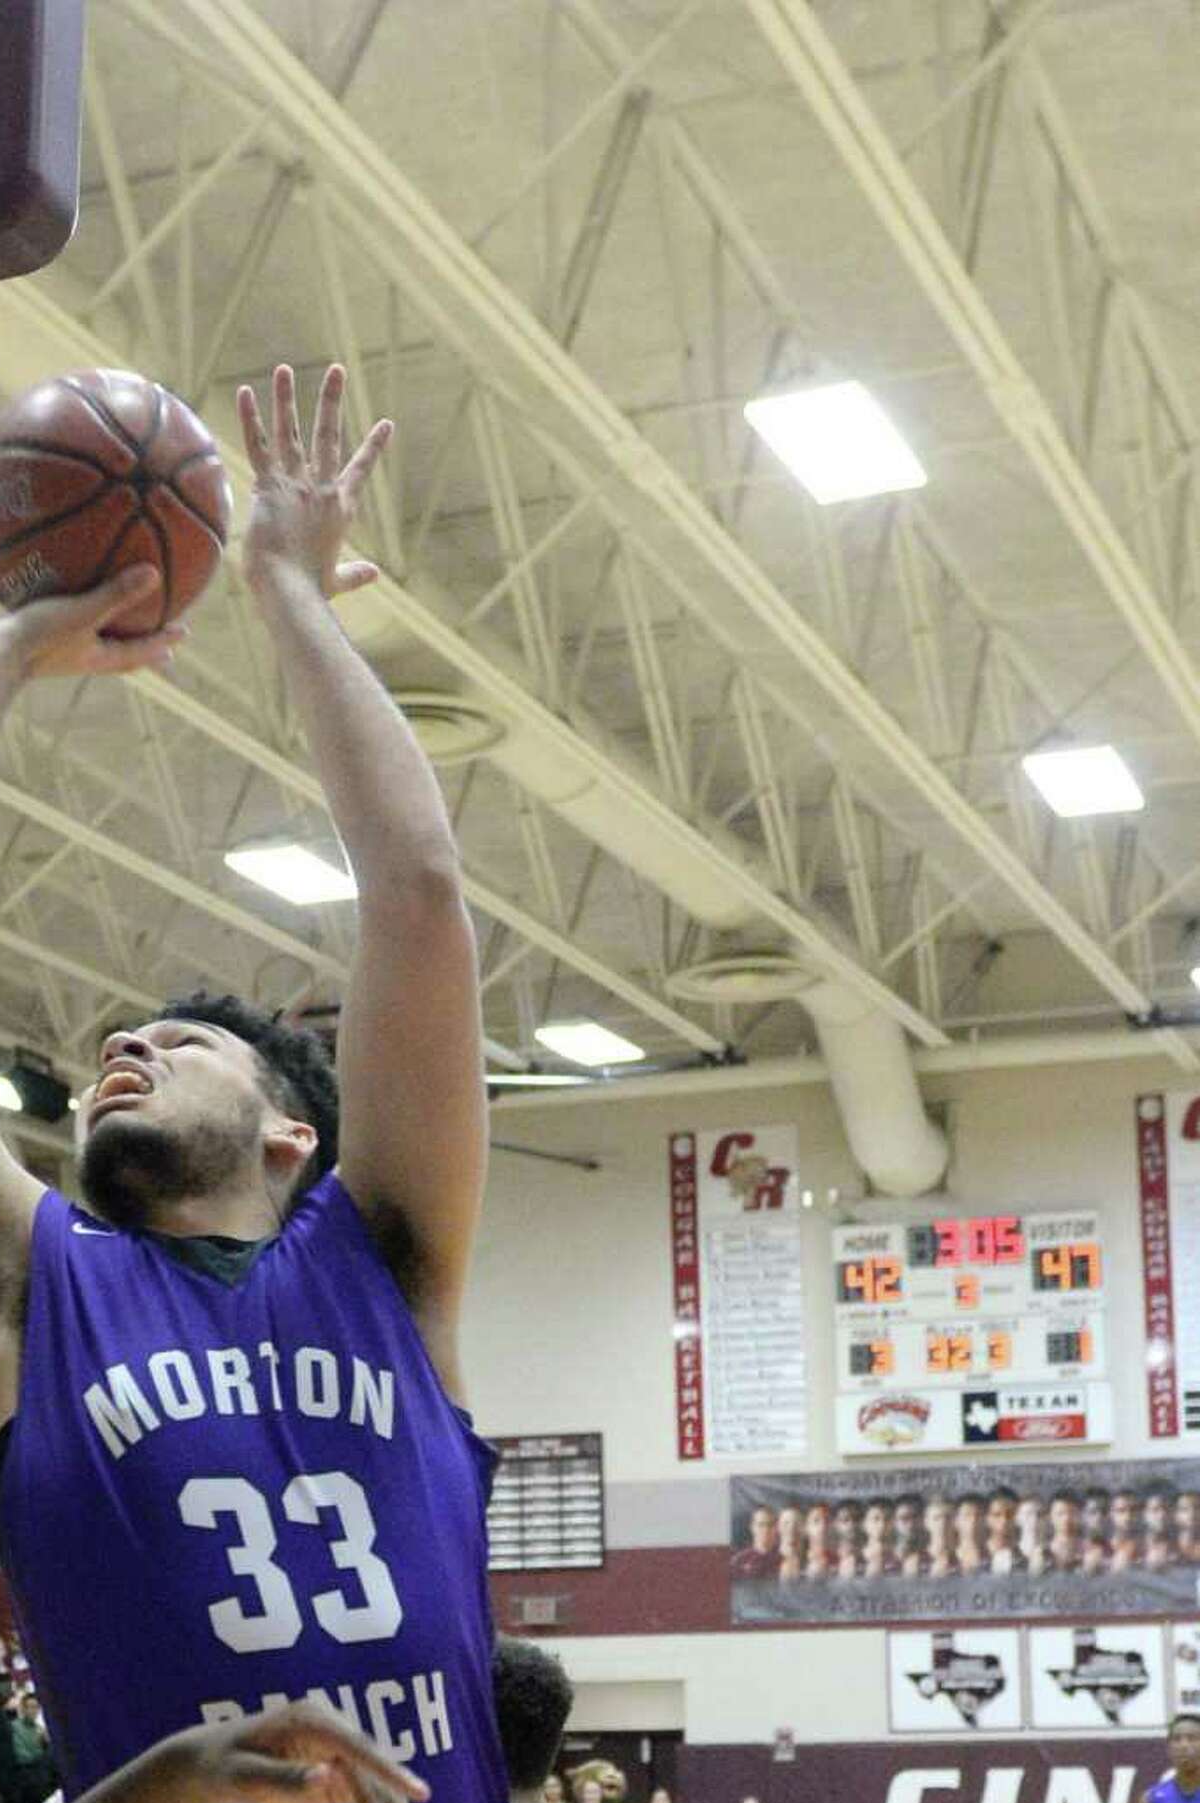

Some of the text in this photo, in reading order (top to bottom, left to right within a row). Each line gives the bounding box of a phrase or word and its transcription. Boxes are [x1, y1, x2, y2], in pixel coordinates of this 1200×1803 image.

[844, 1233, 891, 1250] HOME
[1030, 1220, 1095, 1239] VISITOR
[844, 1257, 901, 1302] 42
[1040, 1243, 1102, 1289] 47
[677, 1284, 700, 1456] BAKETBALL
[83, 1341, 394, 1460] MORTON
[1006, 1394, 1079, 1409] TEXAN
[177, 1471, 403, 1654] 33
